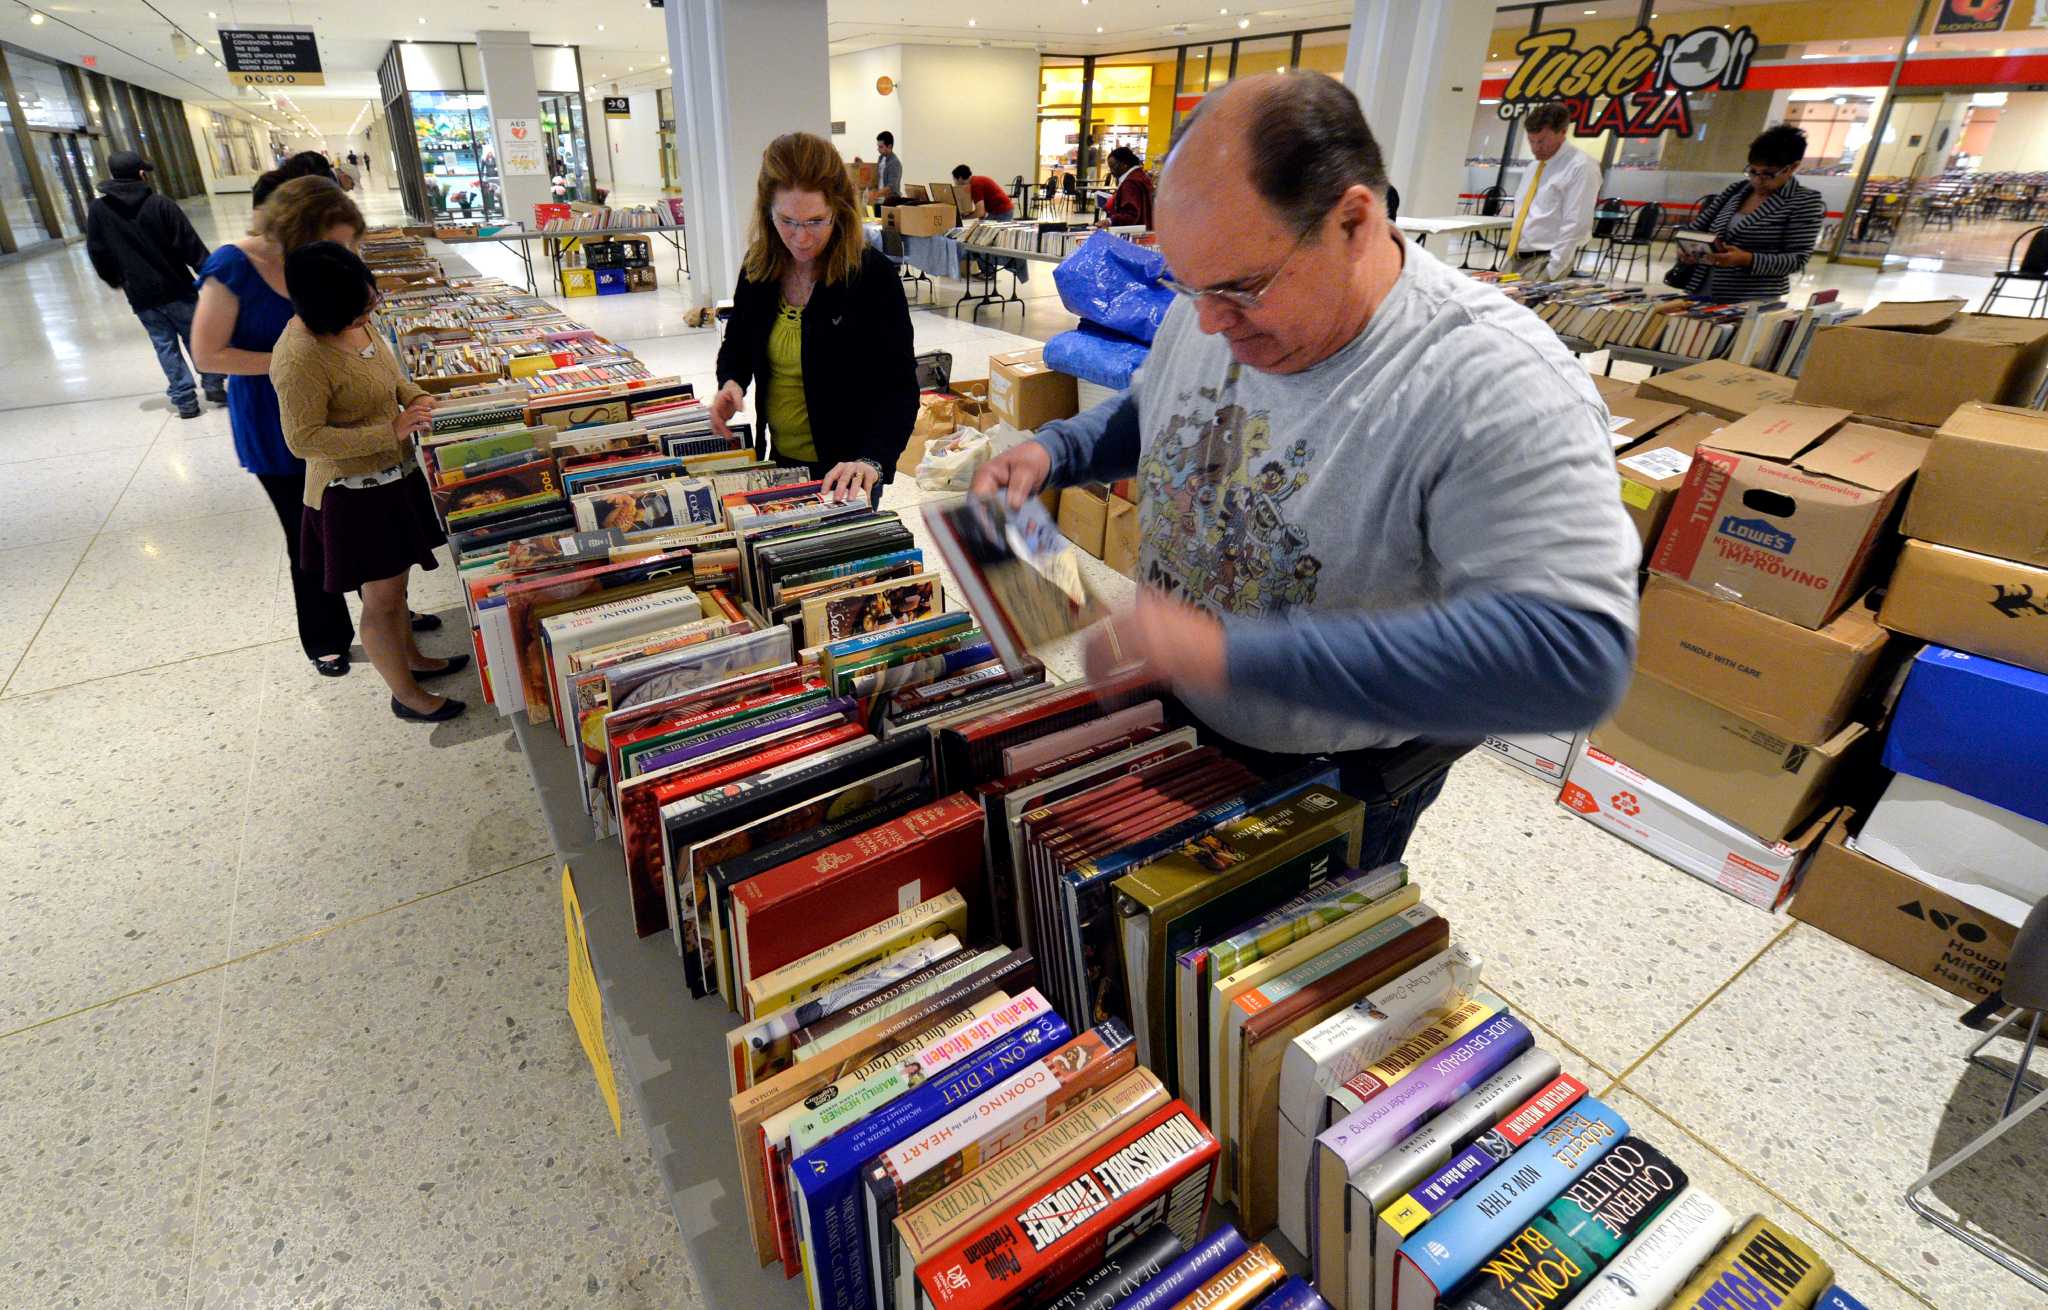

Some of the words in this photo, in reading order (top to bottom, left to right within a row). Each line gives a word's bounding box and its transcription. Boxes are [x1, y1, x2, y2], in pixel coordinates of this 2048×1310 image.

[1504, 29, 1657, 100] Taste
[1500, 103, 1521, 118] OF
[1563, 96, 1692, 135] PLAZA
[541, 471, 554, 492] FOO
[1690, 458, 1731, 524] SMALL
[1757, 464, 1862, 501] lowes.com/moving
[1712, 536, 1750, 554] NEVER
[1726, 523, 1788, 551] LOWE'S
[1718, 546, 1830, 591] IMPROVING
[1680, 640, 1714, 659] HANDLE
[1714, 654, 1737, 669] WITH
[1737, 664, 1761, 679] CARE
[1485, 734, 1511, 754] 325
[1232, 808, 1294, 840] MICROWAVING
[901, 969, 936, 994] CHINESE
[972, 975, 992, 991] BEST
[1933, 963, 1990, 996] Harco
[1941, 951, 2005, 987] Mifflin
[848, 988, 901, 1017] COOKBOOK
[925, 985, 972, 1014] CHOCOLATE
[993, 996, 1040, 1024] Healthy
[877, 1011, 924, 1040] COOKBOOK
[946, 1008, 977, 1029] From
[970, 1021, 998, 1045] Life
[1039, 1015, 1060, 1042] YOU
[1483, 1015, 1514, 1040] JUDE
[892, 1034, 926, 1064] Front
[922, 1032, 974, 1066] Kitchen
[928, 1026, 946, 1043] Our
[854, 1056, 892, 1083] Porch
[982, 1062, 997, 1078] A
[999, 1044, 1027, 1071] ON
[1431, 1035, 1492, 1078] DEVERAUX
[862, 1075, 898, 1102] MARILU
[943, 1072, 983, 1106] DIET
[978, 1071, 1046, 1116] COOKING
[1388, 1080, 1429, 1111] lavender
[1477, 1080, 1494, 1097] LOVE
[1504, 1074, 1523, 1088] FOUR
[1536, 1080, 1578, 1112] BICYCLING
[820, 1095, 862, 1125] HENNER
[1089, 1096, 1119, 1121] The
[1474, 1086, 1505, 1110] LETTERS
[1350, 1103, 1390, 1136] morning
[1505, 1104, 1546, 1137] MEDICINE
[1540, 1111, 1592, 1148] Parker
[901, 1127, 954, 1165] HEART
[1038, 1114, 1099, 1157] REGIONAL
[1400, 1127, 1434, 1153] WILLIAMS
[1415, 1138, 1437, 1154] NIALL
[1572, 1119, 1616, 1160] Robert
[988, 1149, 1042, 1191] ITALIAN
[1092, 1111, 1210, 1200] INADMISSIBLE
[1551, 1148, 1579, 1170] B.
[1503, 1181, 1519, 1198] &
[1511, 1163, 1543, 1192] NOW
[1561, 1144, 1645, 1213] COULTER
[929, 1177, 993, 1226] KITCHEN
[1016, 1172, 1109, 1251] EVIDENCE
[1476, 1189, 1513, 1220] THEN
[1592, 1164, 1675, 1240] CATHERINE
[962, 1222, 1019, 1265] Friedman
[1189, 1238, 1228, 1273] Akeret
[1480, 1226, 1554, 1291] BLANK
[984, 1250, 1022, 1282] Philip
[1086, 1260, 1122, 1287] Simon
[1246, 1248, 1274, 1276] An
[1738, 1228, 1812, 1297] KEN
[1117, 1258, 1162, 1298] DEAD
[1157, 1270, 1185, 1296] TALES
[1176, 1264, 1250, 1310] Enterpri
[1510, 1247, 1583, 1310] POINT
[1689, 1260, 1785, 1310] FOLL
[1048, 1287, 1086, 1310] Scham
